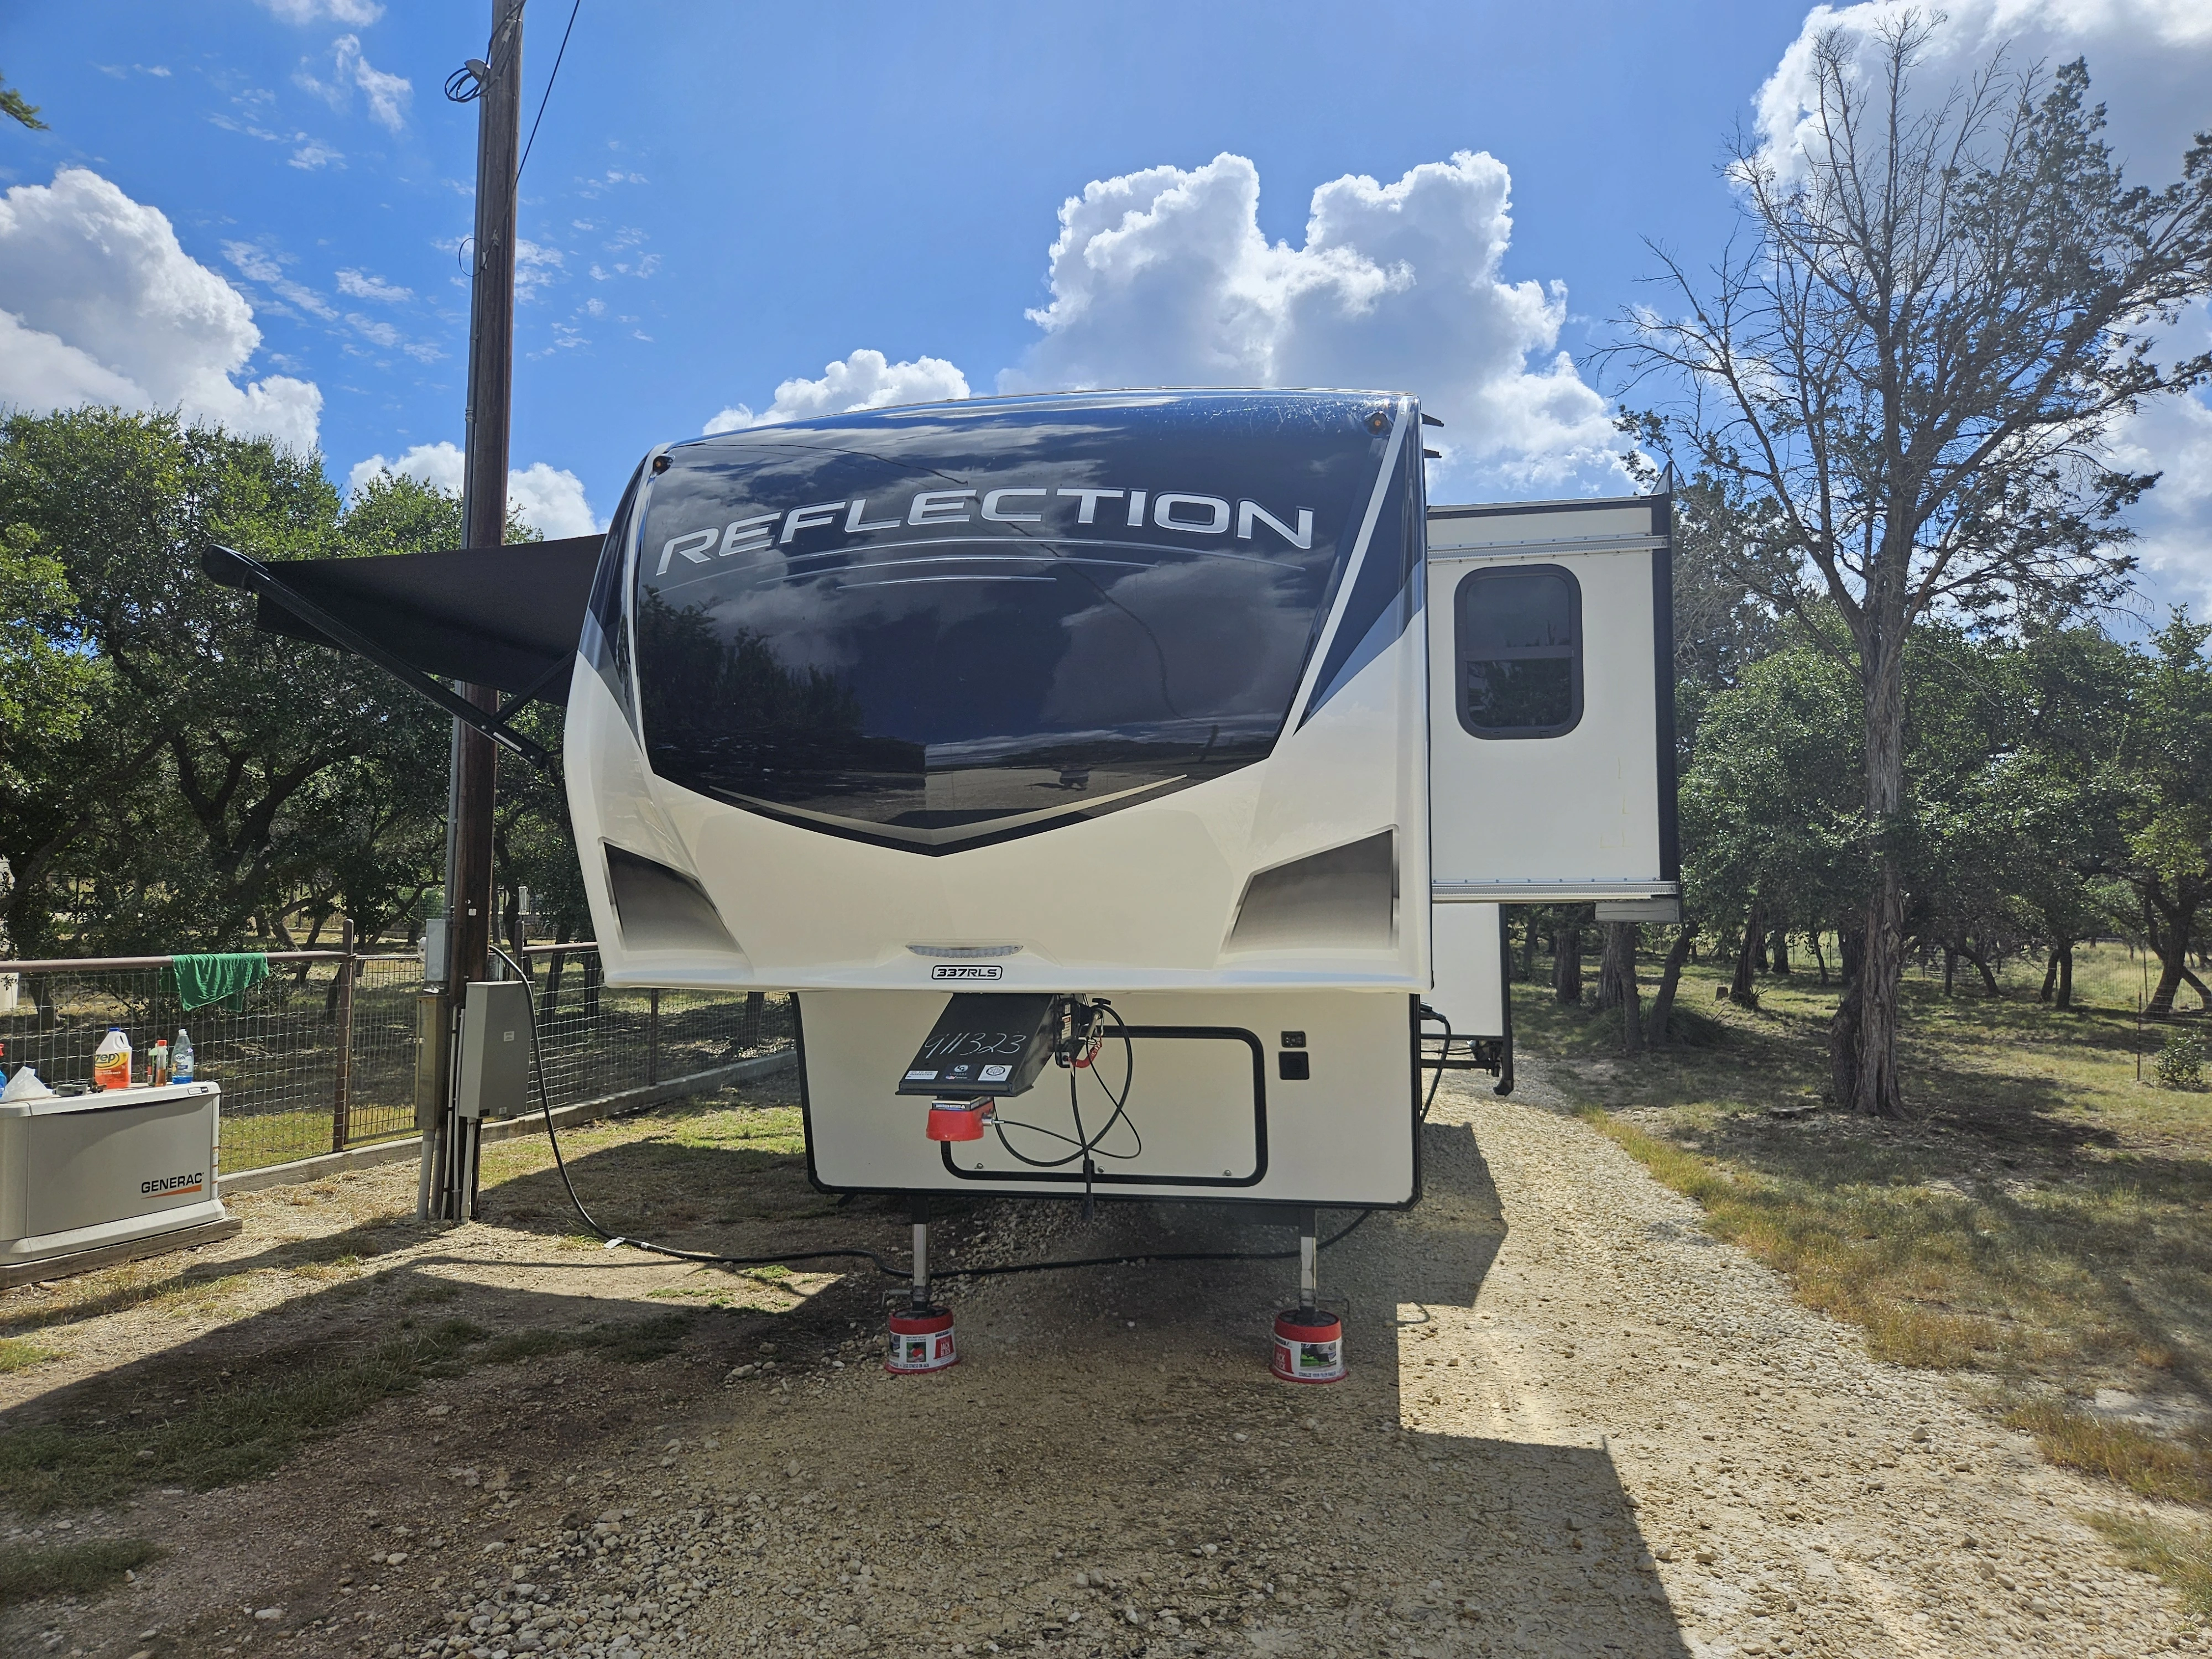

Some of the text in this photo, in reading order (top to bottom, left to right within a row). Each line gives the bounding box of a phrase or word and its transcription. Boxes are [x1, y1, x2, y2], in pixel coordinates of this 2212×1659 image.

[655, 487, 1314, 576] REFLECTION
[936, 968, 997, 977] 337RLS
[142, 1172, 202, 1193] GENERAC
